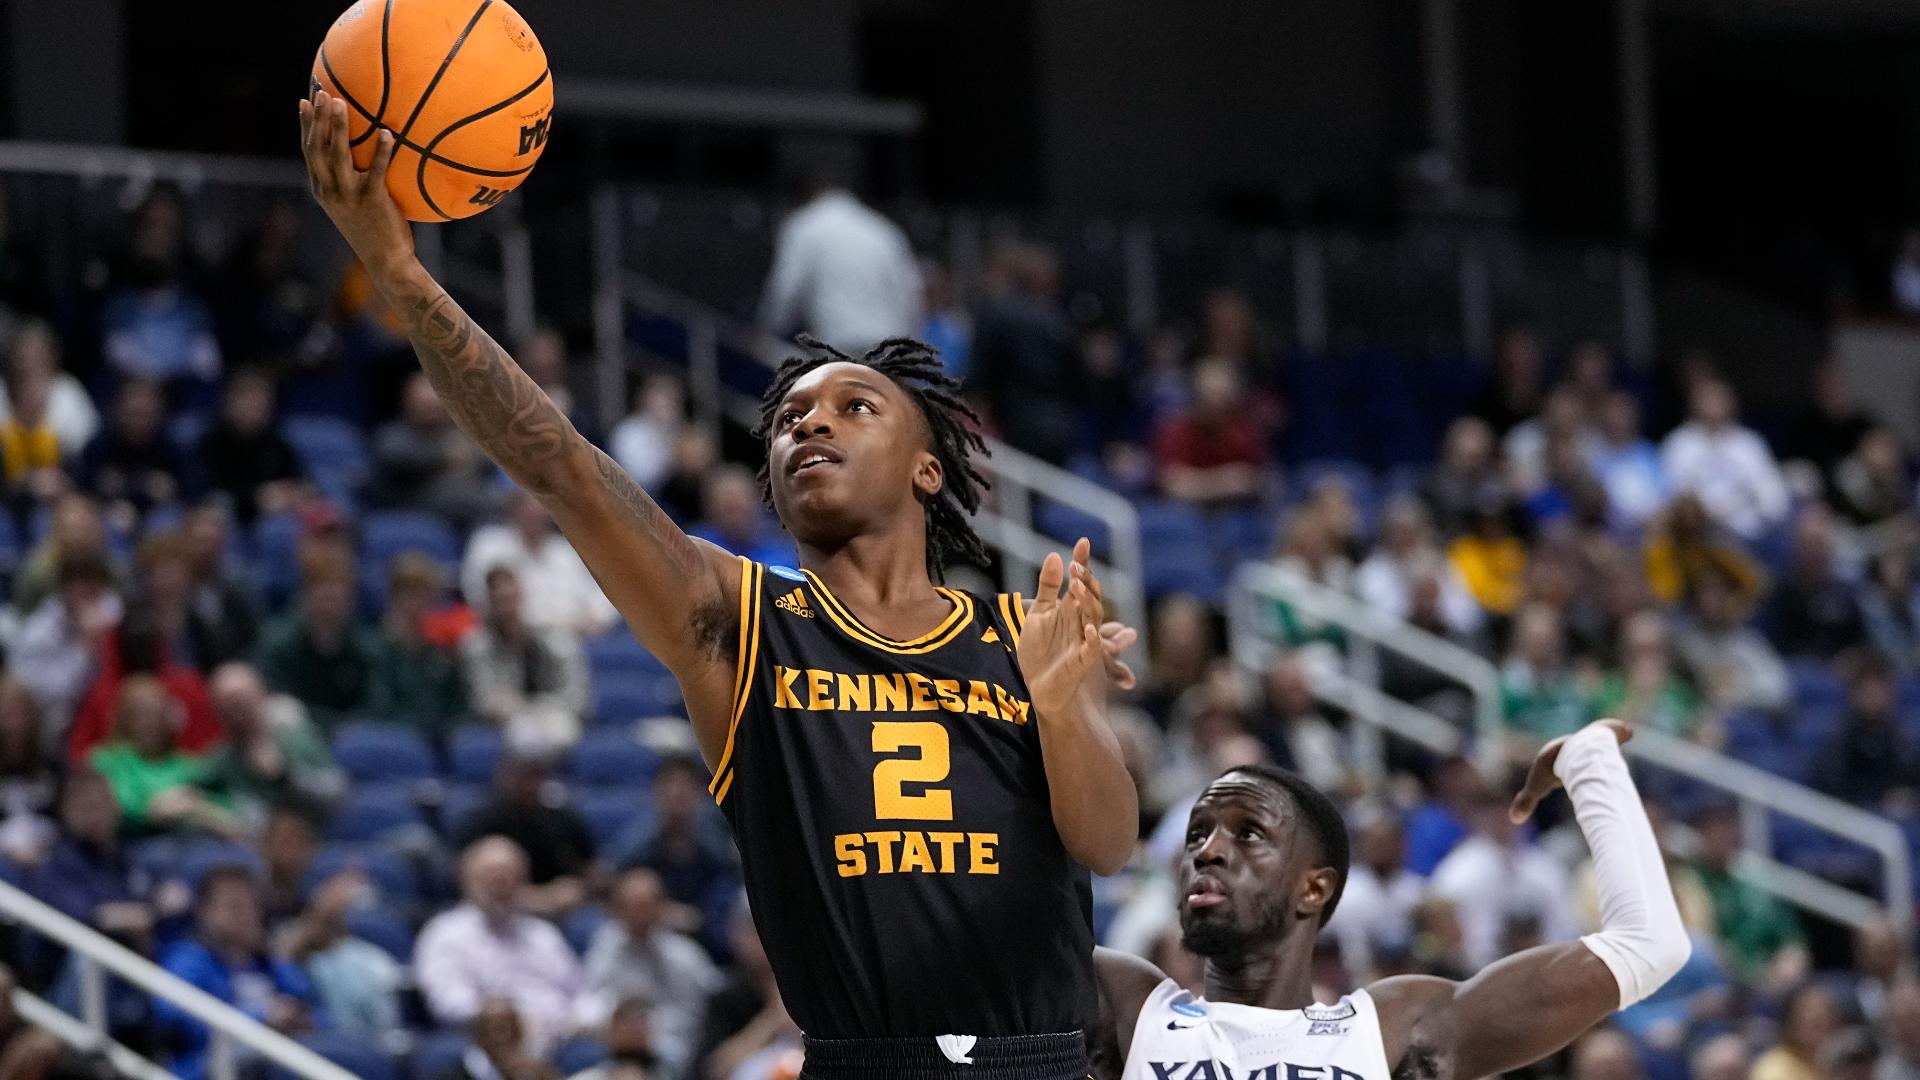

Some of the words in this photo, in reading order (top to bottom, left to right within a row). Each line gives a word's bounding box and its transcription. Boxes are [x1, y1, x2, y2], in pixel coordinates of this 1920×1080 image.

[775, 600, 815, 618] adidas
[774, 665, 1030, 726] KENNESAW
[871, 721, 954, 821] 2
[834, 831, 1000, 878] STATE
